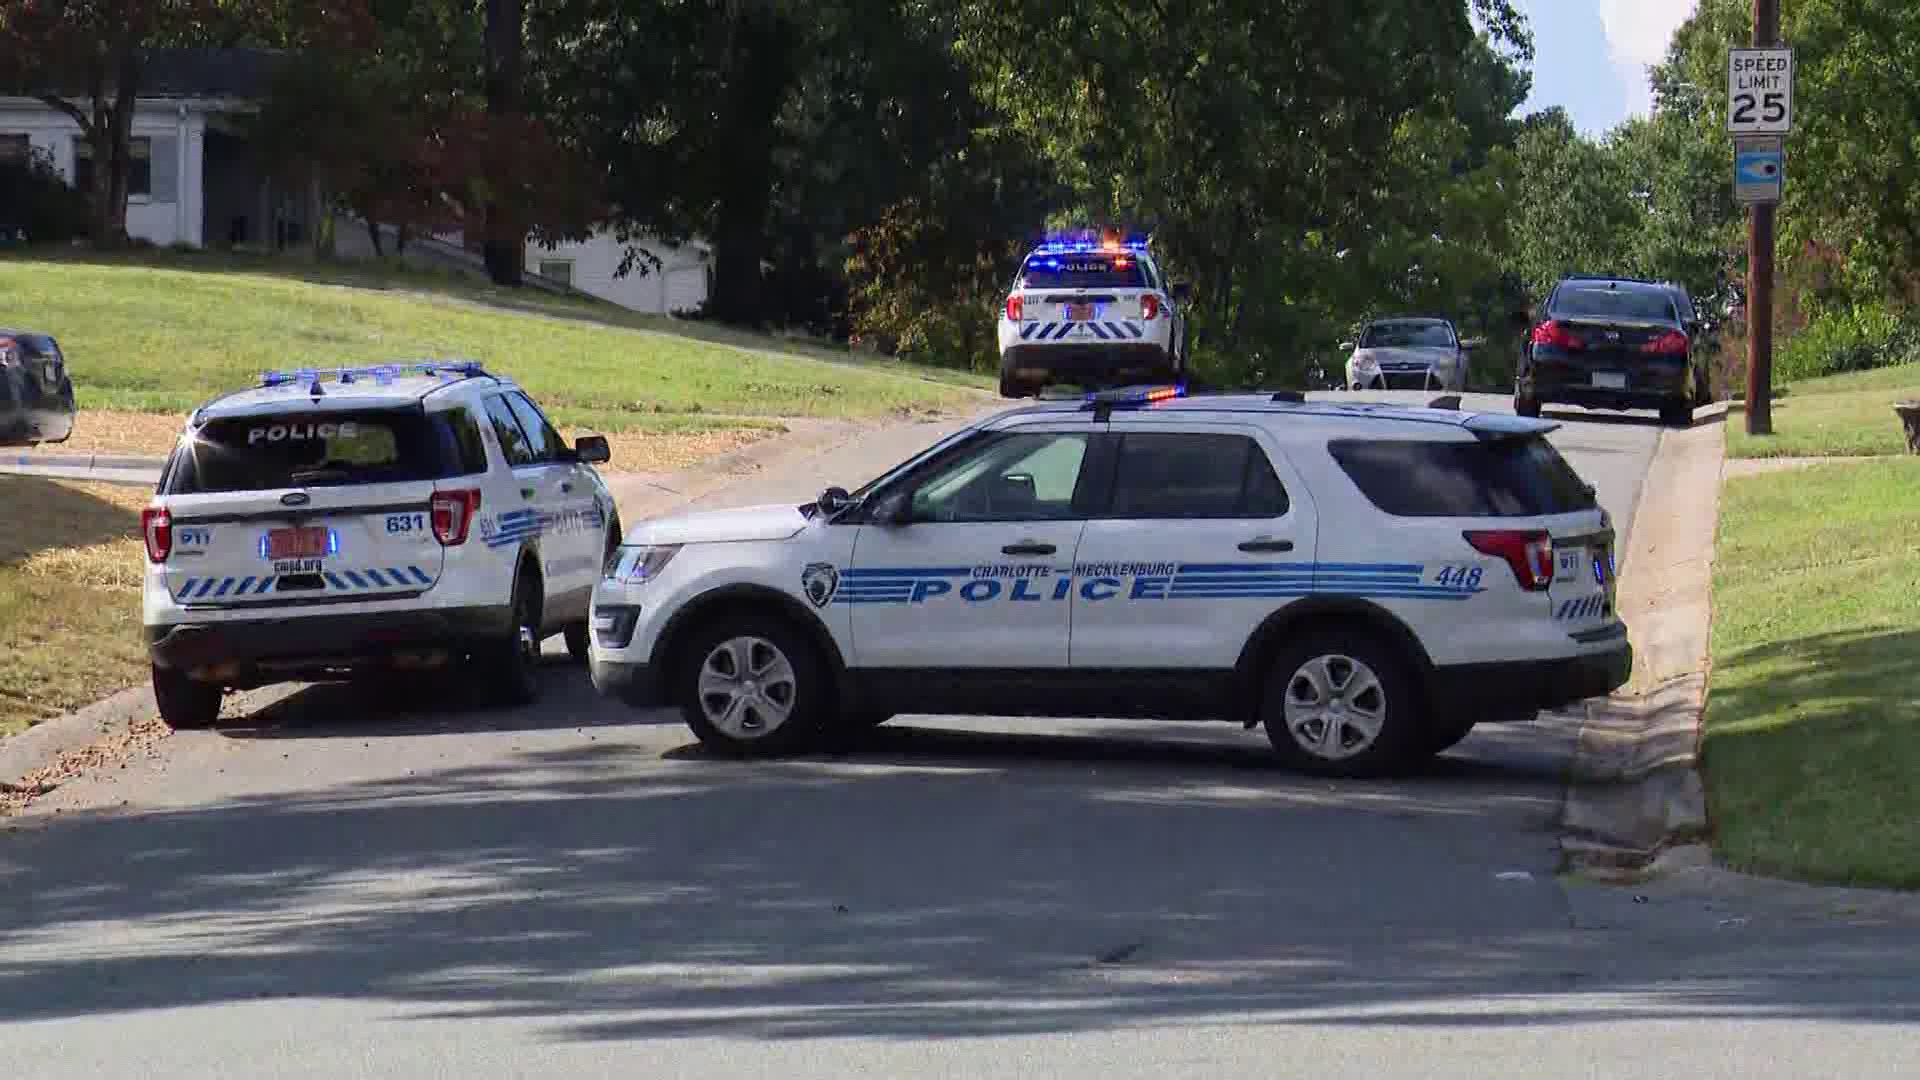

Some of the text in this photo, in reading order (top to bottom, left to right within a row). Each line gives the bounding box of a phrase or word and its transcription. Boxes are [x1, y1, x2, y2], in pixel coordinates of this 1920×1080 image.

[1734, 58, 1787, 72] SPEED
[1738, 76, 1781, 89] LIMIT
[1733, 93, 1785, 123] 25
[1057, 262, 1107, 272] POLICE
[248, 422, 359, 444] POLICE
[386, 515, 424, 533] 631
[181, 529, 210, 545] 911
[972, 564, 1050, 577] CHARLOTTE
[1074, 562, 1174, 577] MECKLENBURG
[1436, 565, 1483, 586] 448
[911, 576, 1168, 602] POLICE
